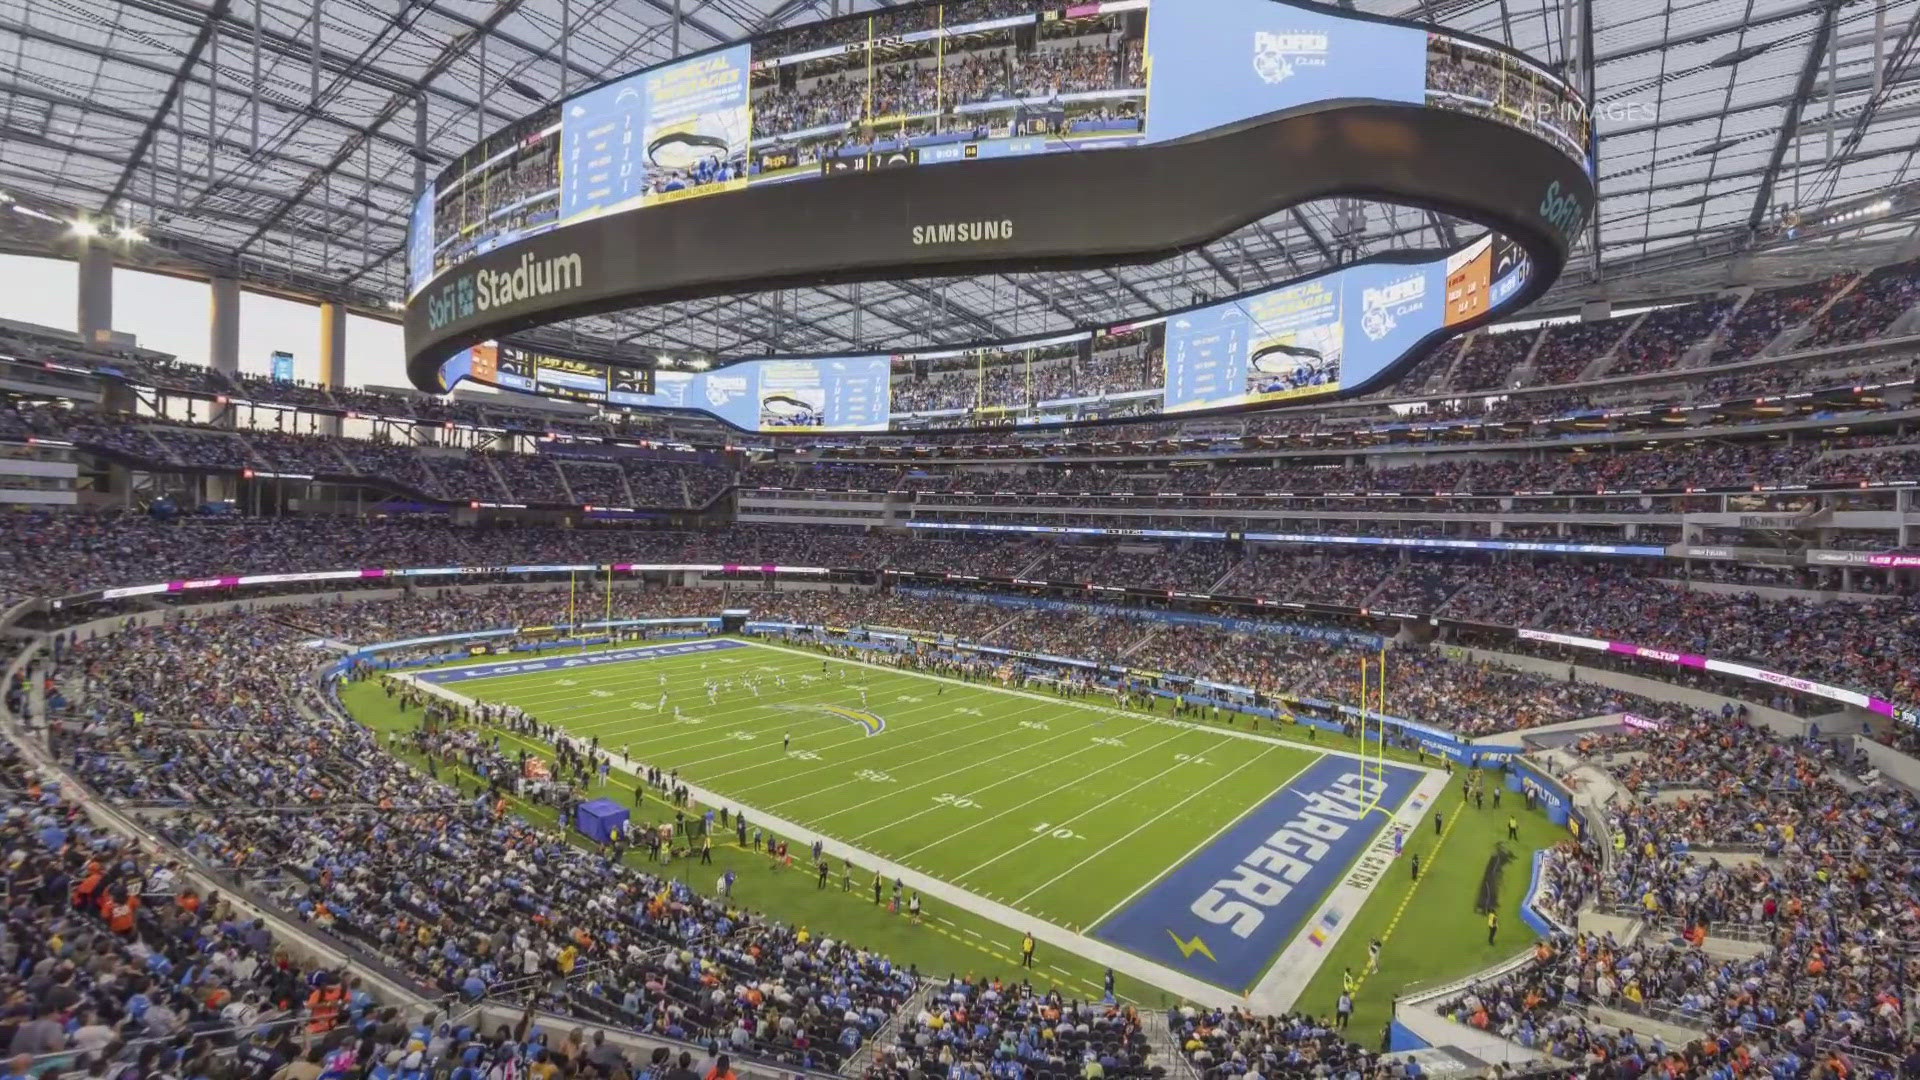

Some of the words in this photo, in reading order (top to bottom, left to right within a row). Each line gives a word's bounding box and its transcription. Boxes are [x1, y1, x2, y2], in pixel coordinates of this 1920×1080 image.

[912, 219, 1013, 245] SAMSUNG
[428, 283, 456, 331] SoFi
[477, 252, 582, 311] Stadium
[464, 663, 547, 677] LOS
[562, 643, 717, 667] ANGELES
[1421, 738, 1463, 757] CHARGERS
[1030, 822, 1074, 839] 10
[1190, 773, 1388, 939] CHARGERS
